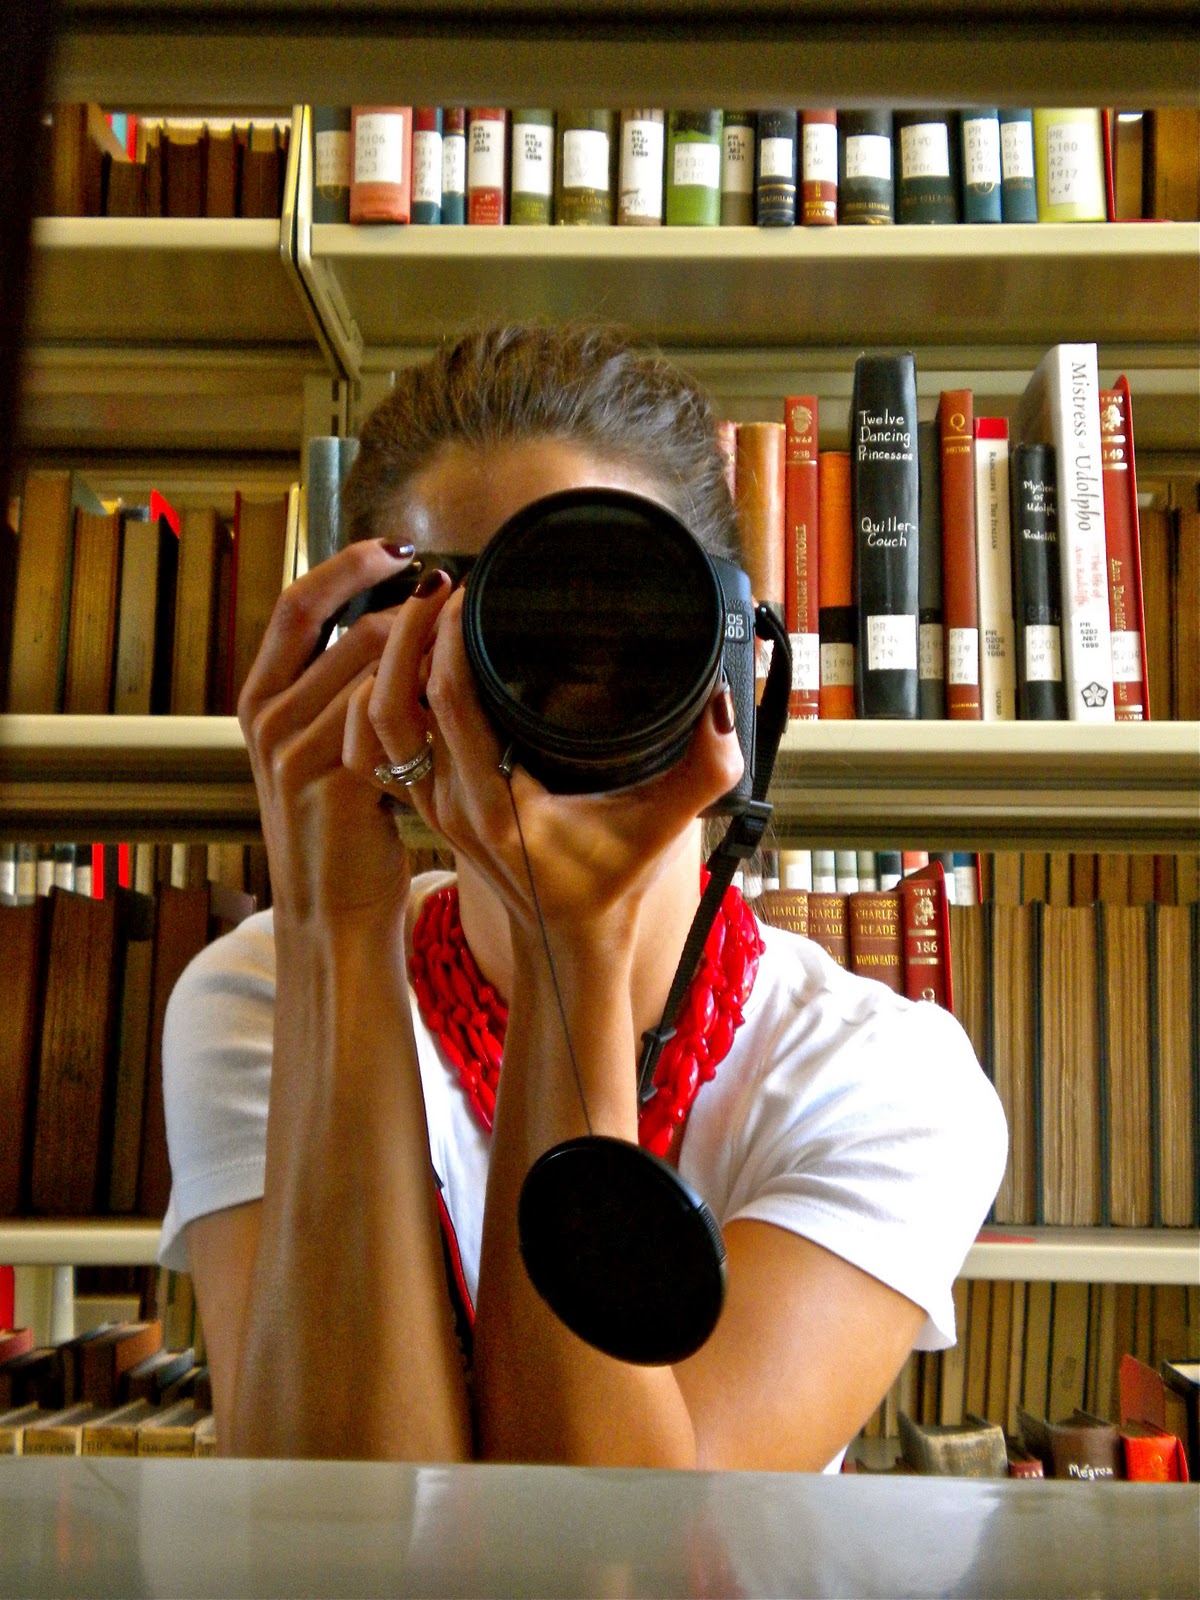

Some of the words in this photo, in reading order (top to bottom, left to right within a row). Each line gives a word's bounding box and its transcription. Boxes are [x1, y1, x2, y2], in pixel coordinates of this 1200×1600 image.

[1049, 130, 1063, 140] PR
[1049, 142, 1078, 152] 5180
[1050, 169, 1078, 180] 1917
[1071, 361, 1090, 437] Mistress
[859, 409, 905, 425] Twelve
[950, 413, 966, 432] Q
[860, 426, 911, 449] Dancing
[858, 445, 913, 462] Princesses
[1103, 448, 1124, 460] 149
[1033, 493, 1044, 502] of
[1070, 454, 1101, 532] Udolpho
[861, 516, 917, 533] Quiller-
[867, 533, 908, 547] Couch
[796, 524, 808, 577] THOMAS
[1111, 557, 1123, 582] Ann
[796, 580, 808, 633] PRINGLE
[726, 613, 744, 626] OS
[725, 625, 745, 639] 0D
[872, 623, 887, 631] PR
[950, 631, 964, 641] PR
[771, 905, 808, 917] HARLES
[855, 909, 899, 920] CHARLES
[860, 924, 897, 935] READE
[916, 941, 938, 953] 186
